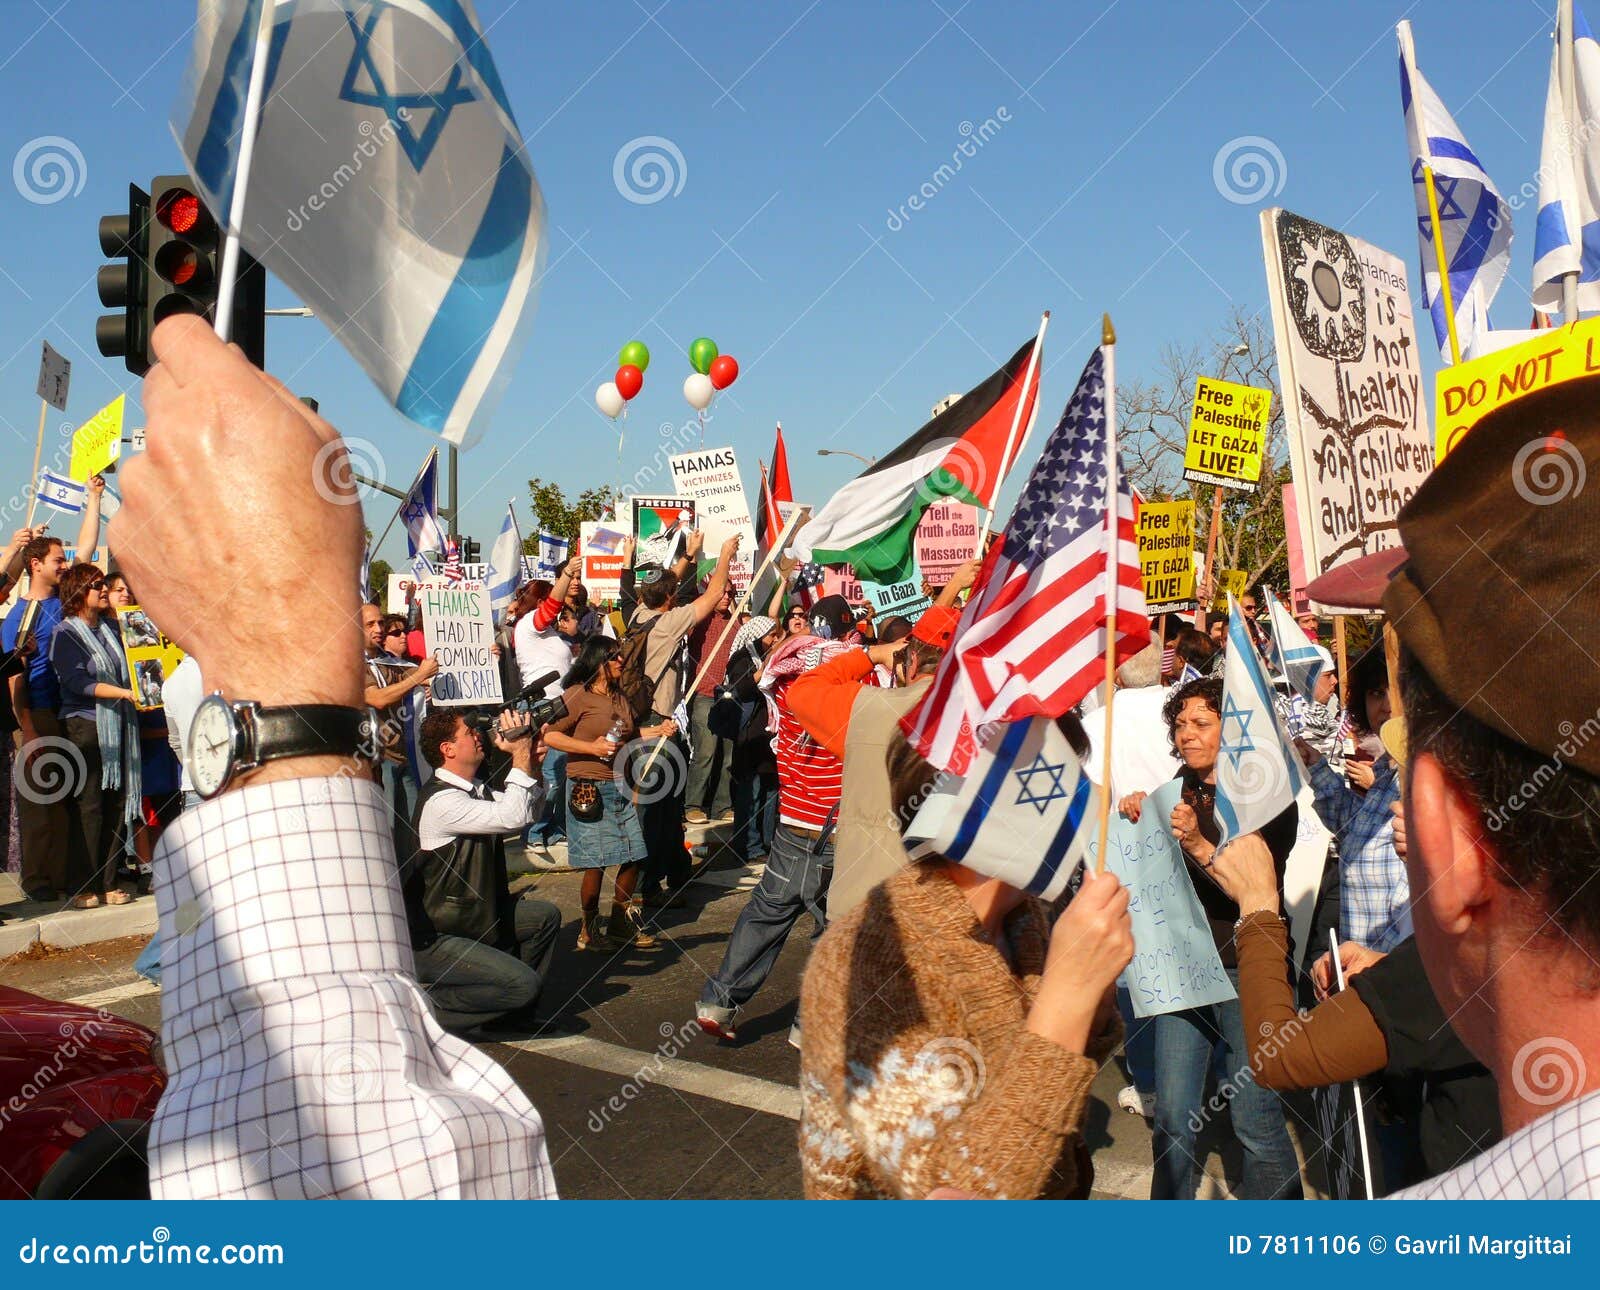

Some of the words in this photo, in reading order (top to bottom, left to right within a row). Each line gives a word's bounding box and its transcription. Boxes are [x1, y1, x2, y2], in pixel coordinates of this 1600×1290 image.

[1358, 254, 1407, 292] Hamas
[1375, 288, 1396, 325] is
[1373, 328, 1410, 369] not
[1443, 378, 1487, 416] DO
[1496, 346, 1564, 401] NOT
[1197, 384, 1233, 407] Free
[1345, 370, 1418, 430] healthy
[1194, 405, 1261, 432] Palestine
[1192, 429, 1217, 448] LET
[1221, 435, 1259, 455] GAZA
[672, 451, 735, 475] HAMAS
[1199, 449, 1245, 475] LIVE!
[1313, 434, 1350, 484] for
[1360, 430, 1430, 481] children
[682, 472, 734, 488] VICTIMIZES
[1184, 470, 1256, 493] ANSWERcoalition.org
[638, 500, 690, 508] FREEDOM
[708, 504, 727, 515] FOR
[929, 507, 949, 521] Tell
[1321, 485, 1358, 541] and
[1365, 478, 1419, 515] othe
[918, 523, 943, 538] Truth
[952, 523, 975, 537] Gaza
[1140, 511, 1169, 530] Free
[920, 547, 975, 561] Massacre
[1139, 532, 1190, 552] Palestine
[1140, 560, 1160, 576] LET
[1163, 556, 1189, 573] GAZA
[877, 590, 891, 606] in
[891, 582, 916, 601] Gaza
[1145, 577, 1181, 601] LIVE!
[427, 591, 480, 617] HAMAS
[436, 622, 464, 643] HAD
[469, 621, 484, 643] IT
[458, 669, 502, 699] ISRAEL
